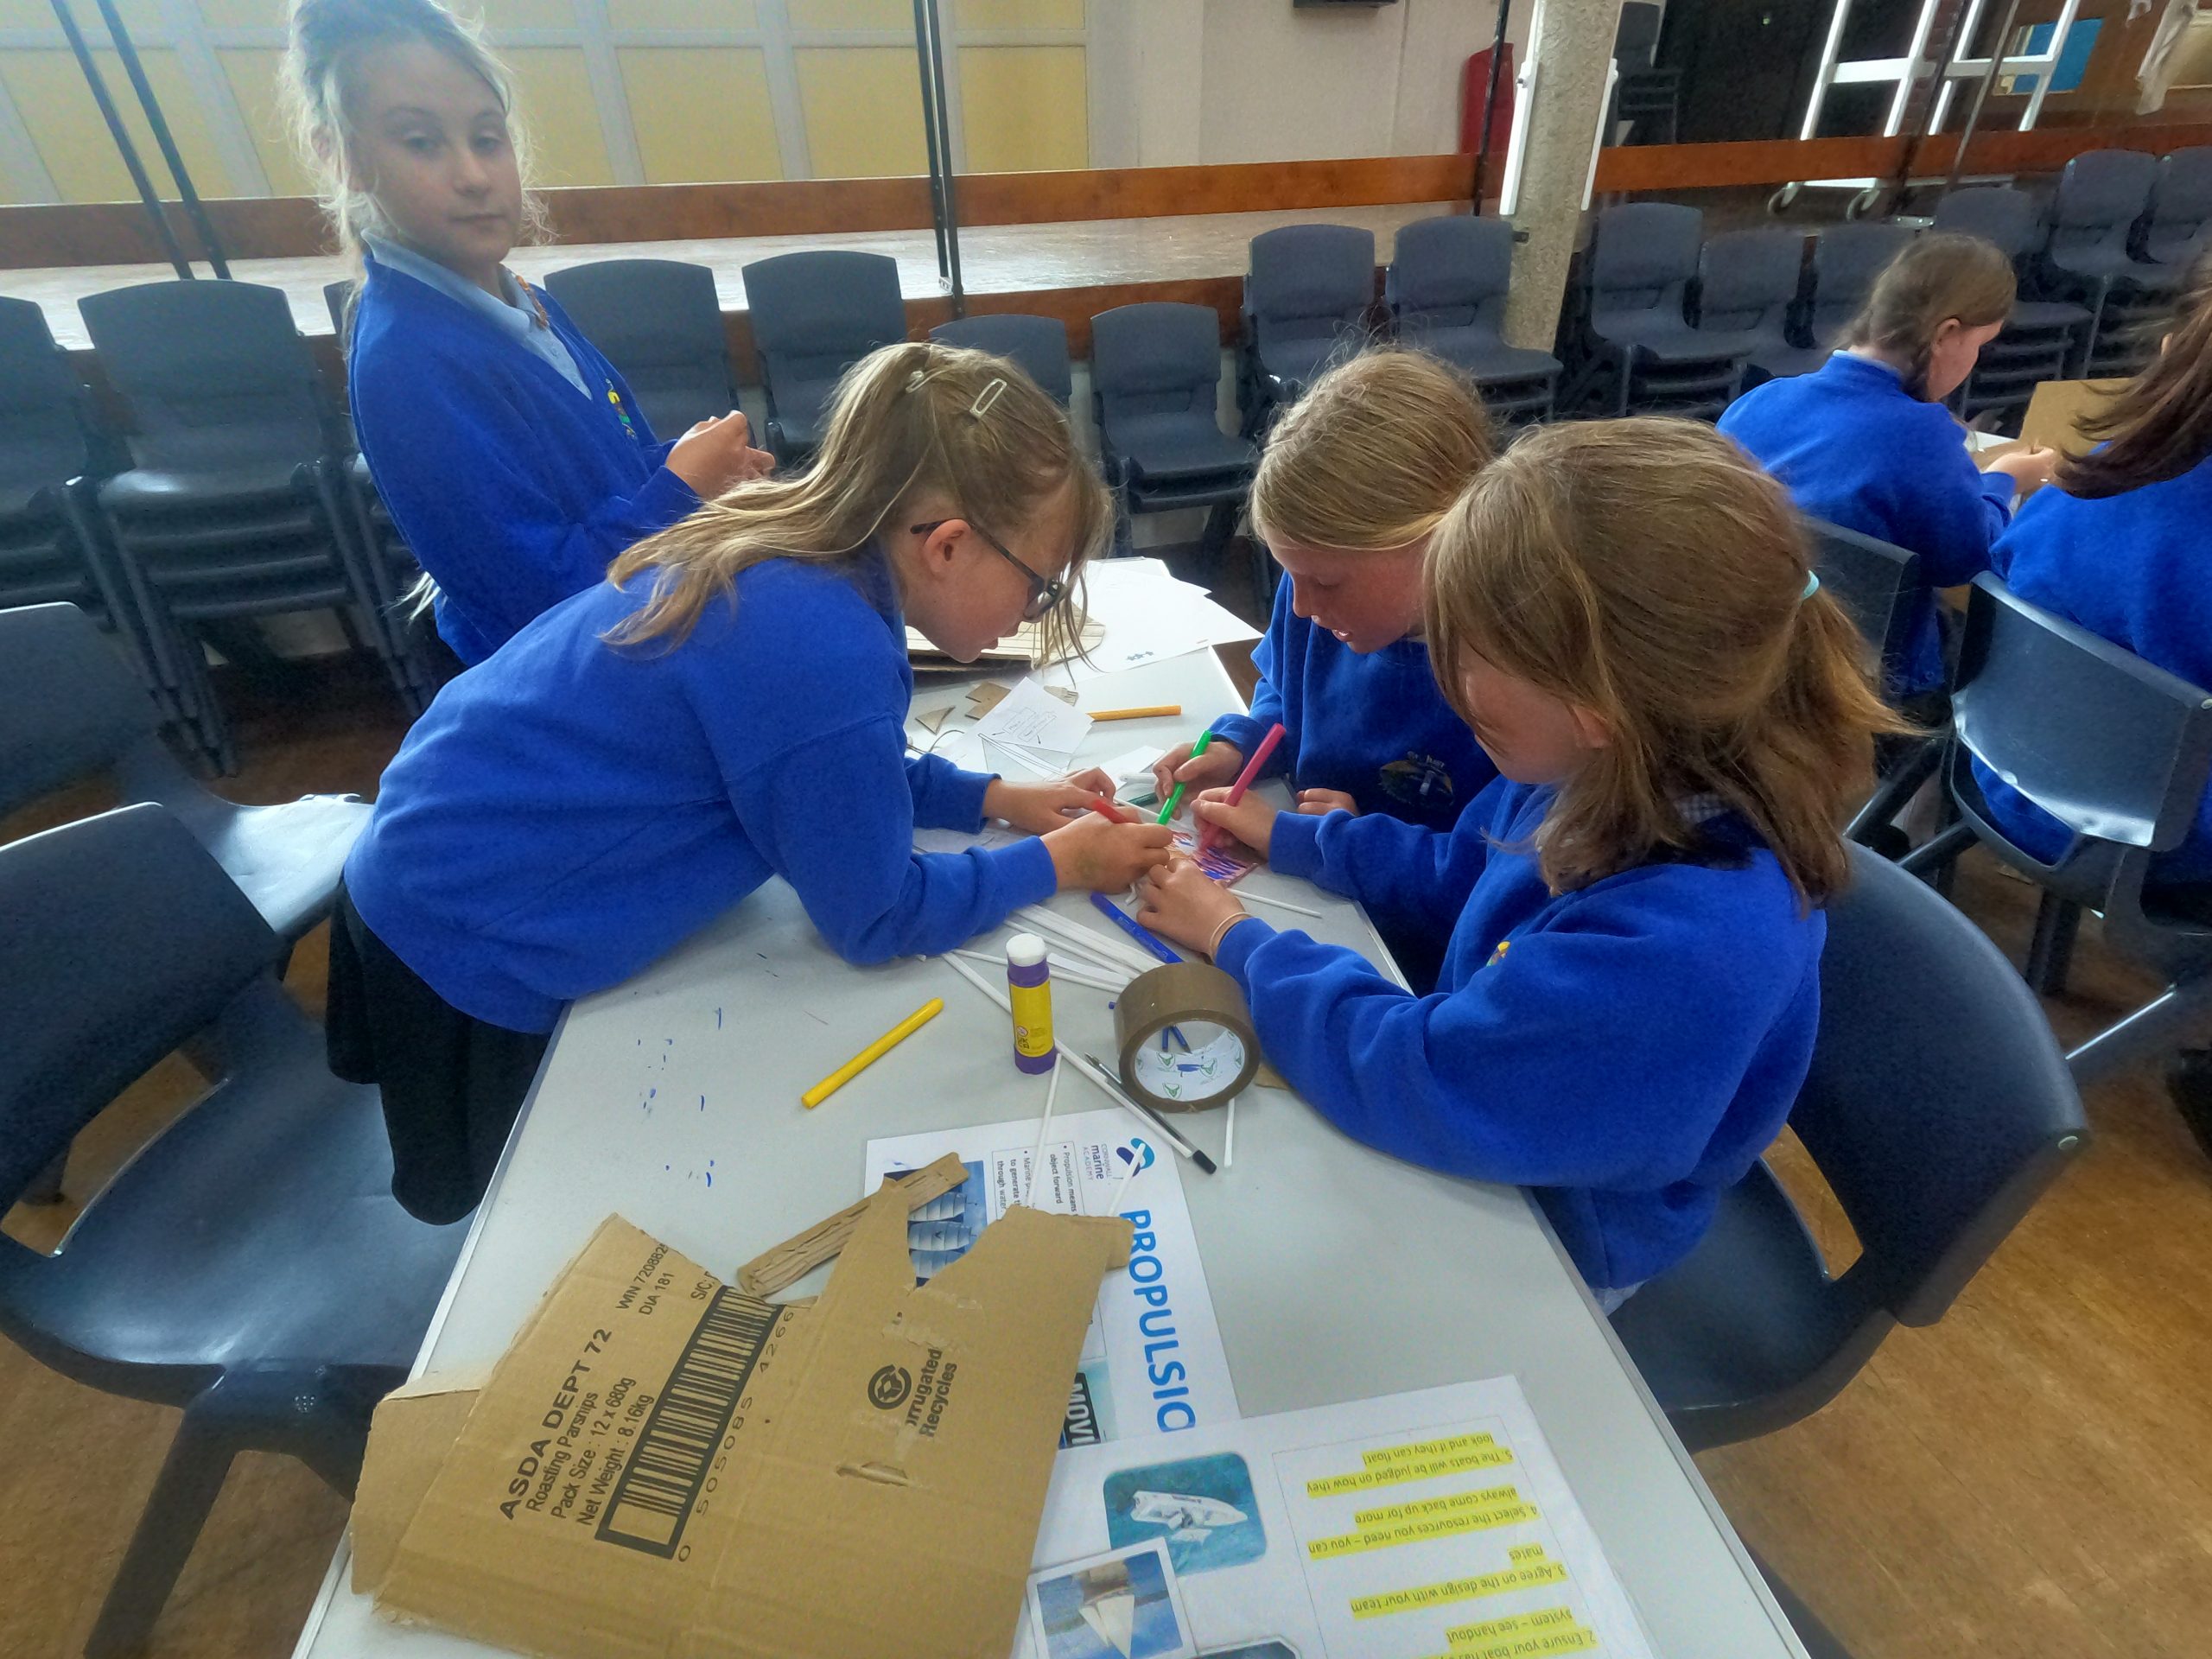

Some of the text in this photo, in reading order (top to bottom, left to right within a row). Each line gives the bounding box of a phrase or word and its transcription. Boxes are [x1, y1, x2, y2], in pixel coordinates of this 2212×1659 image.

[1084, 1147, 1093, 1180] ACADEMY
[1091, 1145, 1104, 1179] marine
[996, 1160, 1006, 1188] through
[1023, 1158, 1032, 1181] Marine
[1009, 1167, 1020, 1198] generate
[1050, 1154, 1064, 1204] object forward
[1064, 1152, 1073, 1187] Propulsion
[1069, 1188, 1077, 1212] means
[615, 1286, 641, 1309] WIN
[639, 1272, 675, 1315] DIA 181
[605, 1376, 637, 1408] 680g
[918, 1363, 957, 1438] Recycles
[603, 1410, 616, 1420] x
[499, 1328, 613, 1520] ASDA DEPT 72
[589, 1421, 611, 1438] 12
[1440, 1440, 1446, 1452] if
[1450, 1438, 1469, 1450] and
[1472, 1434, 1493, 1447] look
[525, 1391, 599, 1511] Roasting Parsnips
[1394, 1447, 1413, 1458] can
[1414, 1443, 1438, 1455] they
[576, 1498, 601, 1525] Net
[617, 1394, 655, 1437] 8.16kg
[1451, 1455, 1479, 1467] boats
[1481, 1452, 1500, 1463] The
[1414, 1465, 1426, 1476] be
[1427, 1460, 1448, 1473] will
[1359, 1474, 1372, 1484] on
[1376, 1466, 1412, 1481] judged
[1306, 1481, 1331, 1493] they
[1334, 1478, 1357, 1487] how
[550, 1482, 581, 1519] Pack
[1355, 1487, 1516, 1523] always come back up for more
[1472, 1513, 1491, 1525] the
[1497, 1508, 1527, 1522] Select
[1417, 1516, 1470, 1533] resources
[1363, 1530, 1391, 1545] need
[1394, 1526, 1414, 1537] you
[1308, 1543, 1328, 1554] can
[1331, 1538, 1351, 1549] you
[1509, 1546, 1543, 1560] mates
[1503, 1573, 1517, 1584] on
[1520, 1567, 1553, 1580] Agree
[1441, 1581, 1478, 1596] design
[1480, 1577, 1499, 1589] the
[1383, 1593, 1410, 1607] your
[1414, 1588, 1438, 1601] with
[1351, 1599, 1381, 1612] team
[1531, 1607, 1573, 1625] system
[1499, 1621, 1519, 1632] see
[1446, 1625, 1496, 1643] handout
[1514, 1640, 1540, 1653] your
[1543, 1636, 1583, 1649] Ensure
[1484, 1647, 1510, 1659] boat
